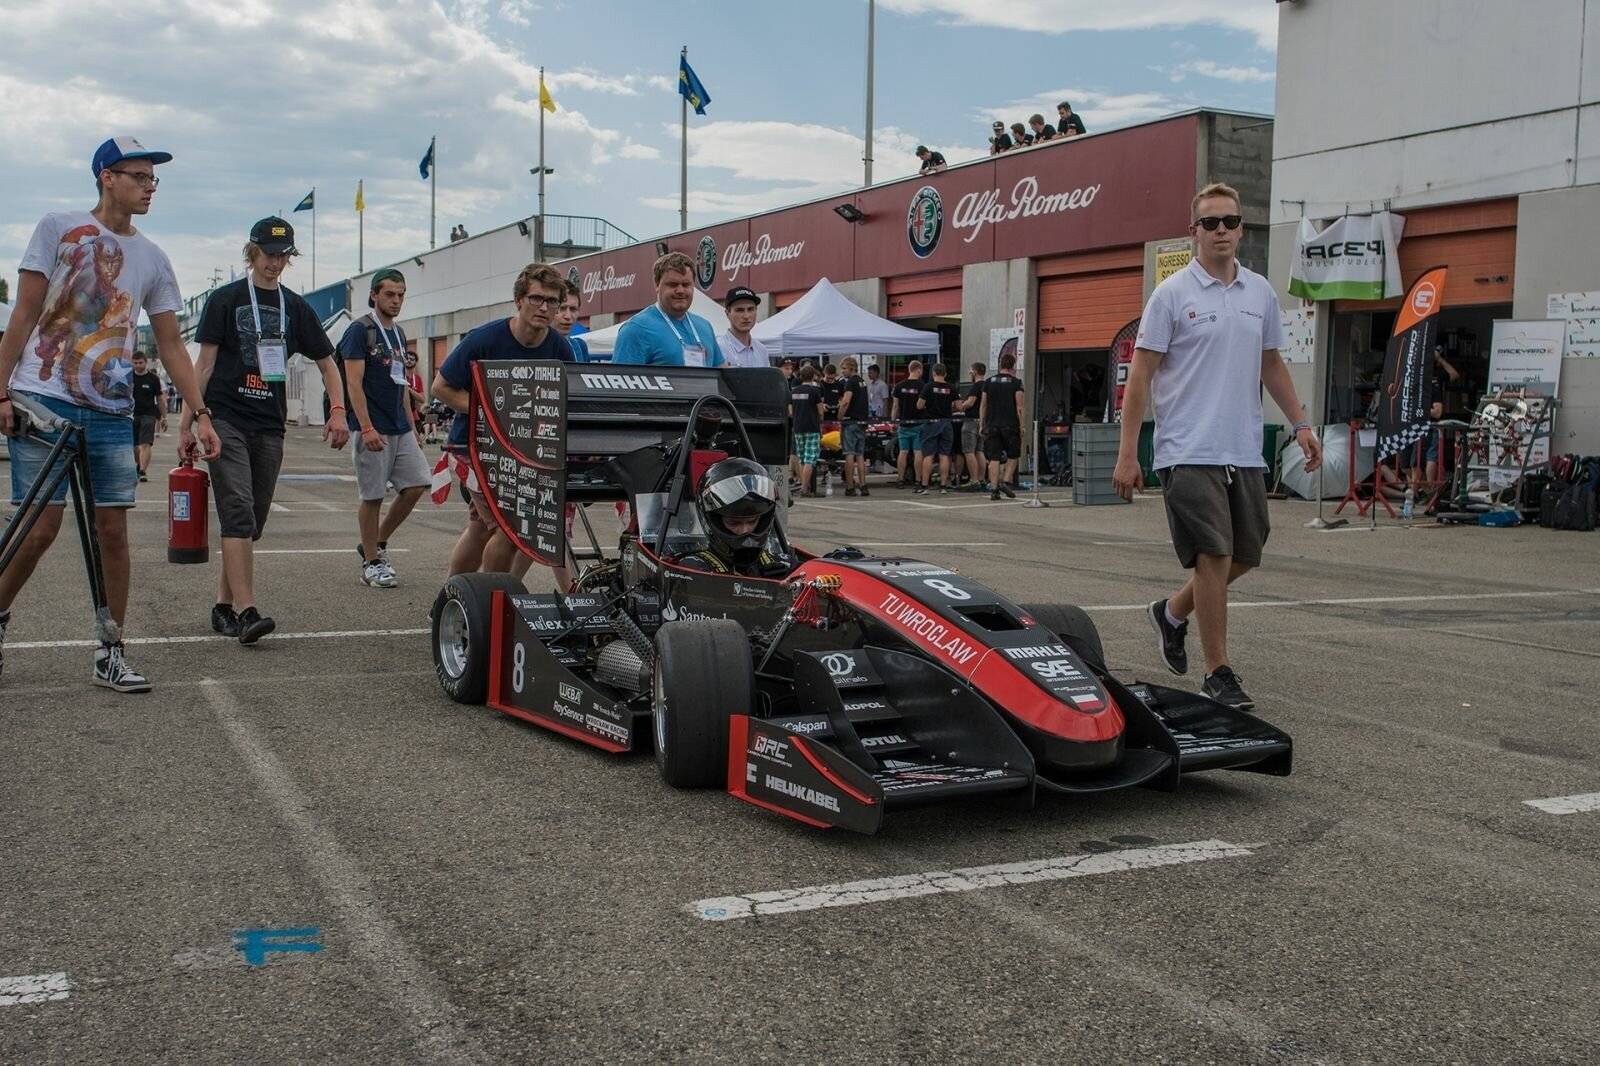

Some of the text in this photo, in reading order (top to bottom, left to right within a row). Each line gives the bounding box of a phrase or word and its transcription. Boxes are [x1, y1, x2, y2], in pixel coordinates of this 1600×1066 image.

[952, 176, 1101, 243] Alfa Romeo
[722, 233, 806, 282] Alfa Romeo
[582, 265, 637, 303] Alfa Romeo
[1015, 309, 1025, 327] 12
[486, 368, 510, 379] SIEMENS
[534, 366, 561, 382] MAHLE
[580, 373, 675, 391] MAHLE
[1400, 329, 1418, 423] RACEYARD
[238, 386, 274, 398] BILTEMA
[533, 404, 560, 418] NOKIA
[516, 425, 533, 439] Altair
[499, 456, 517, 475] CEPA
[543, 510, 558, 520] BOSCH
[923, 579, 973, 601] 8
[880, 593, 906, 615] TU
[1003, 645, 1072, 660] MAHLE
[512, 642, 526, 694] 8
[1031, 659, 1082, 678] SAE
[765, 774, 841, 813] HELUKABEL
